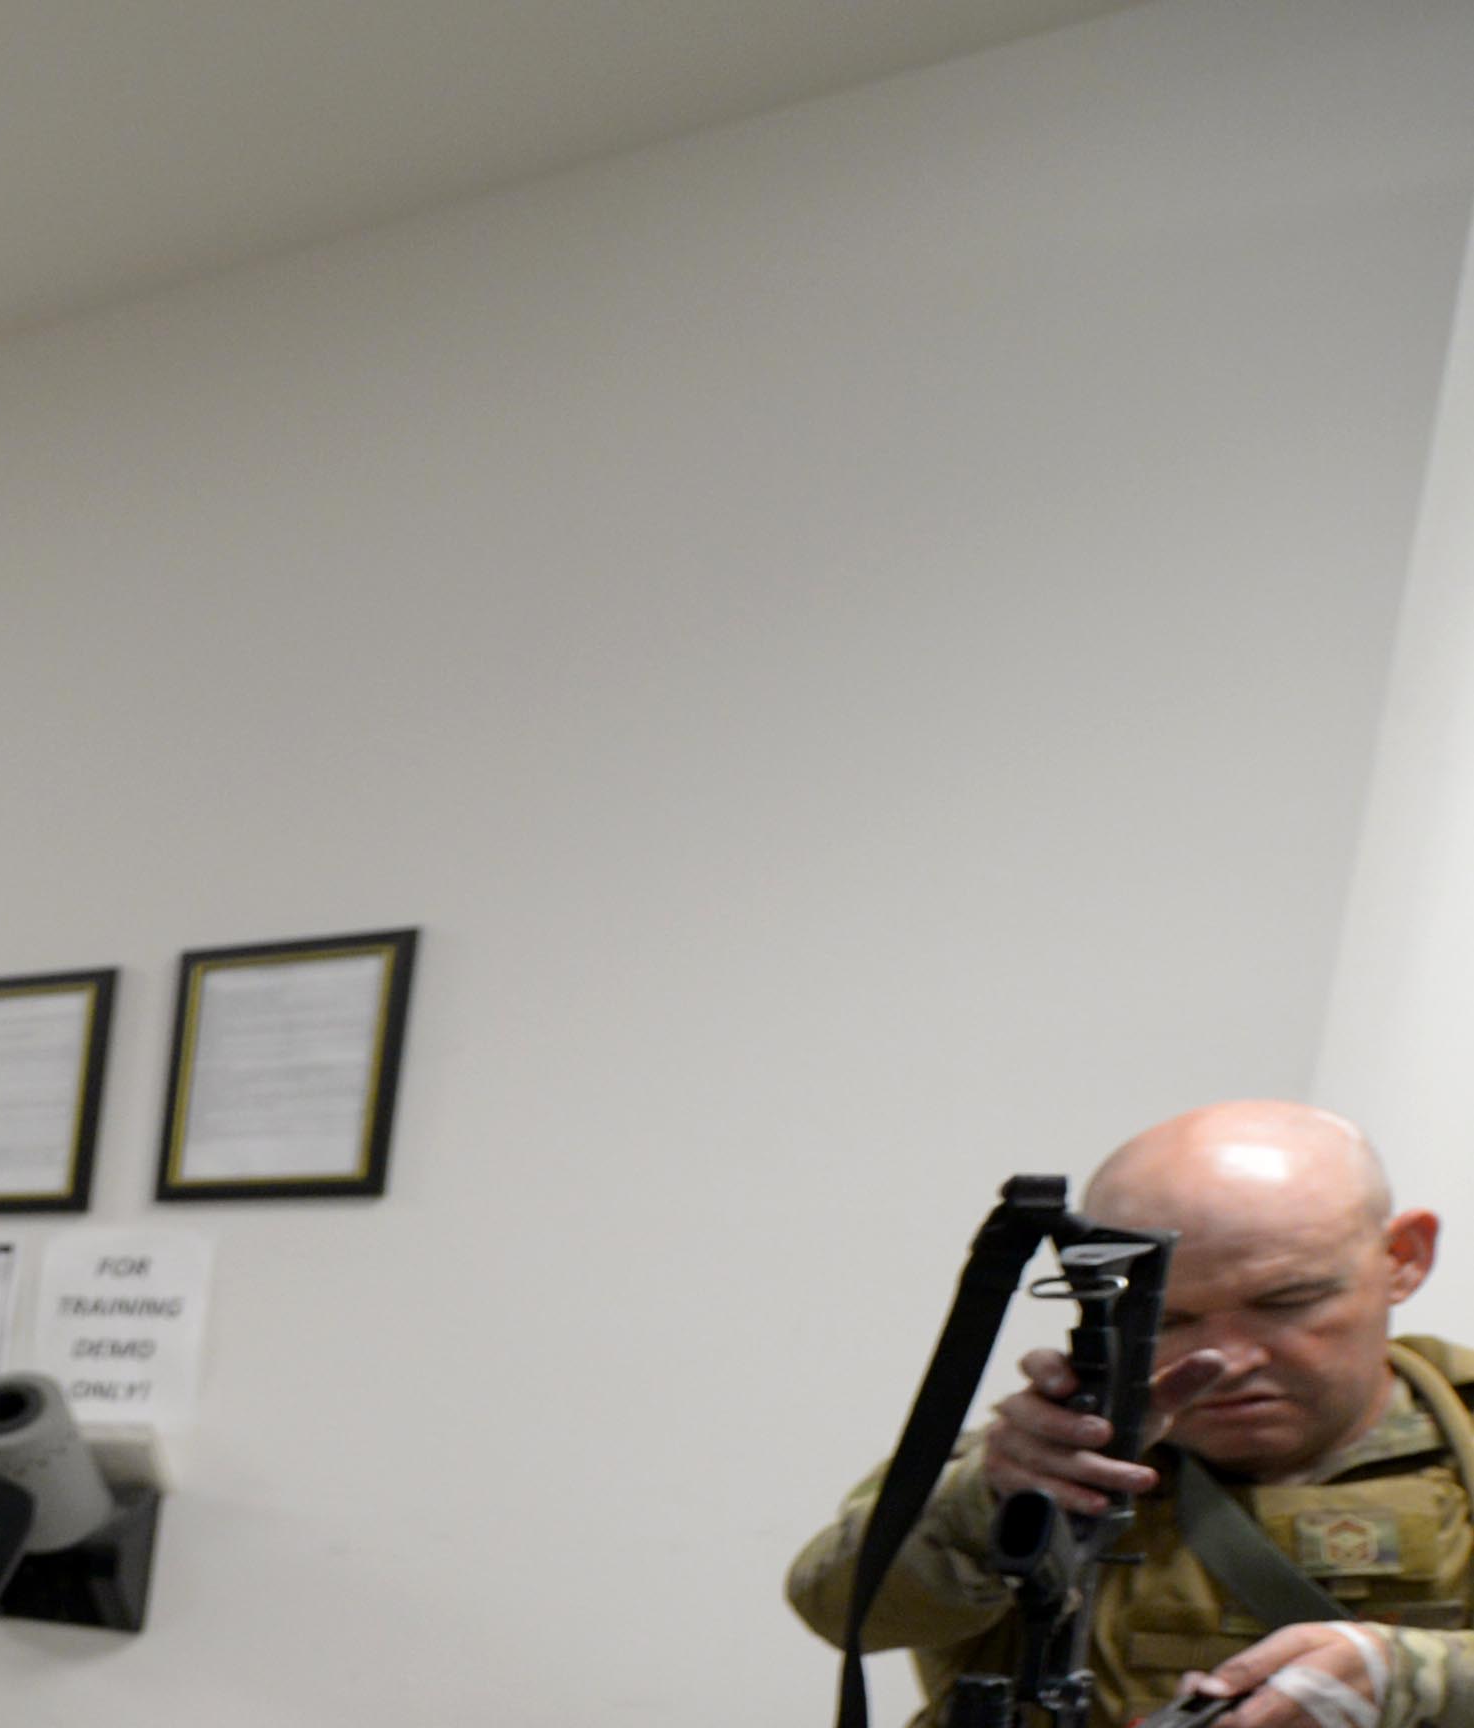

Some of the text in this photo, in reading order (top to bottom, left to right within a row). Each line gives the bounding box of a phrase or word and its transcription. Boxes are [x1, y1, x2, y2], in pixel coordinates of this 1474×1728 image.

[96, 1256, 154, 1279] FOR
[56, 1296, 185, 1319] TRAINING
[70, 1338, 158, 1360] DEMO
[71, 1380, 154, 1401] ONLY!
